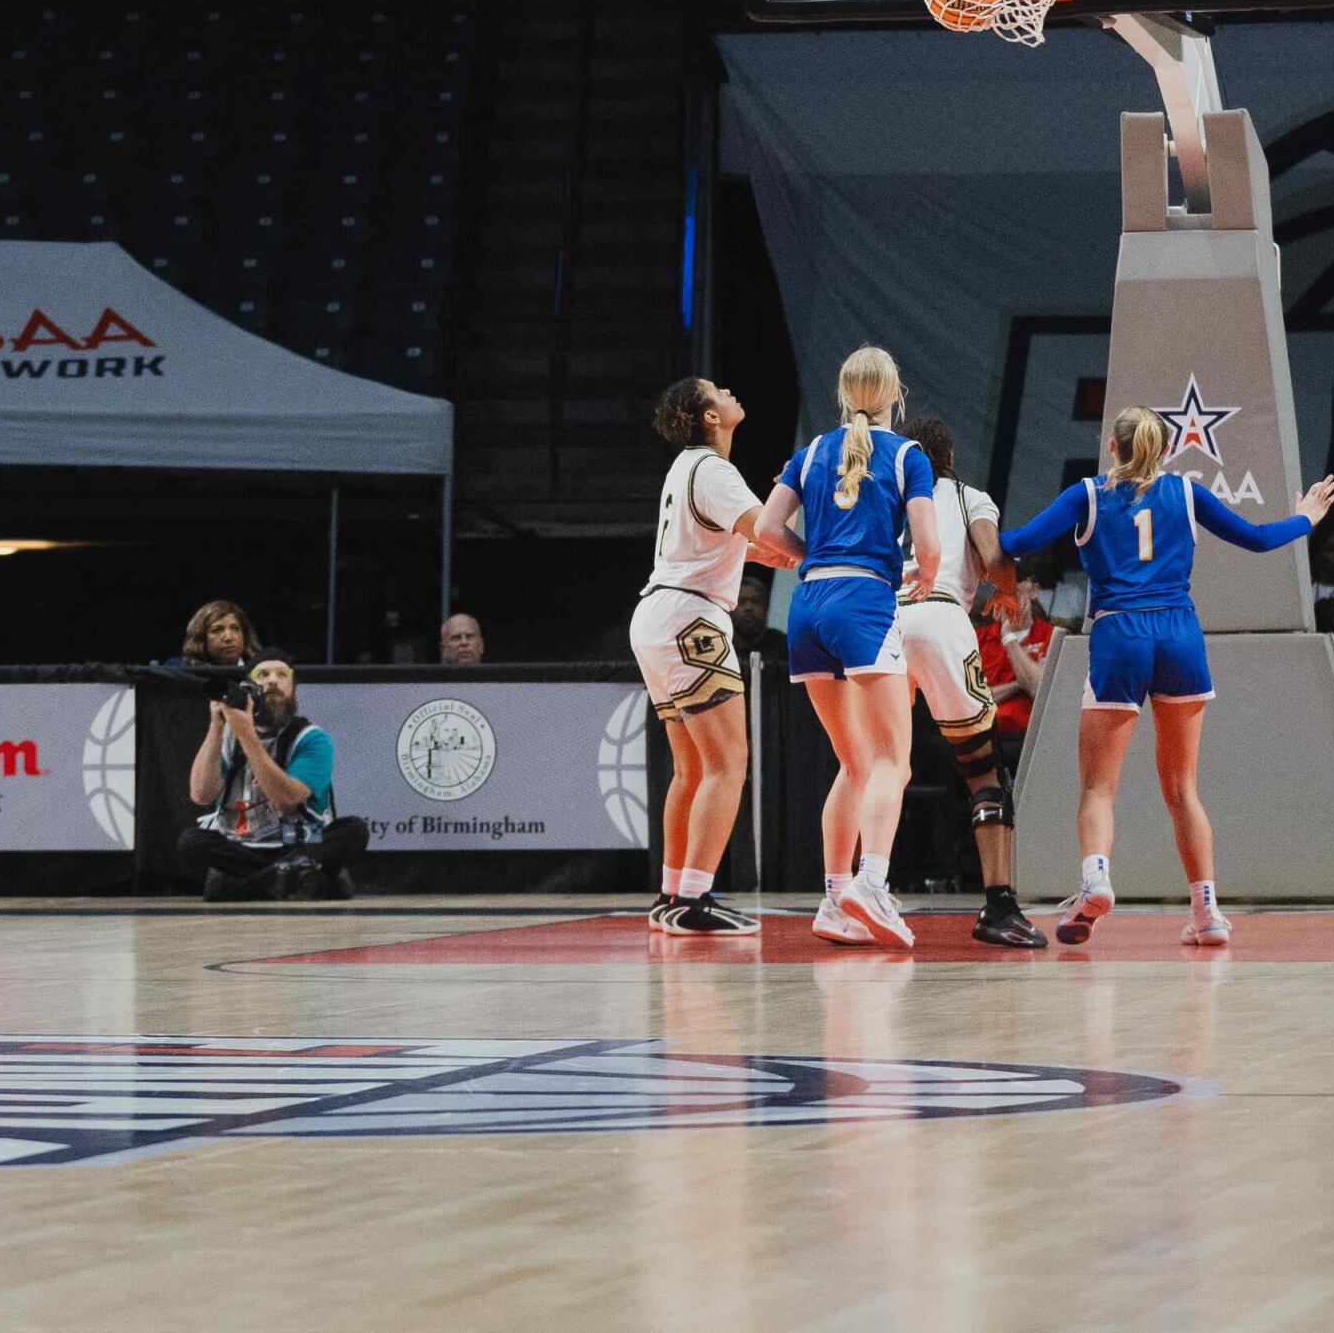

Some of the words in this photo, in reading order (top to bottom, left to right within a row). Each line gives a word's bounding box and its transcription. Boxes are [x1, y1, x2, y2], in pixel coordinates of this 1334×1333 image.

[1134, 509, 1154, 561] 1
[395, 815, 419, 834] of
[422, 815, 546, 840] Birmingham
